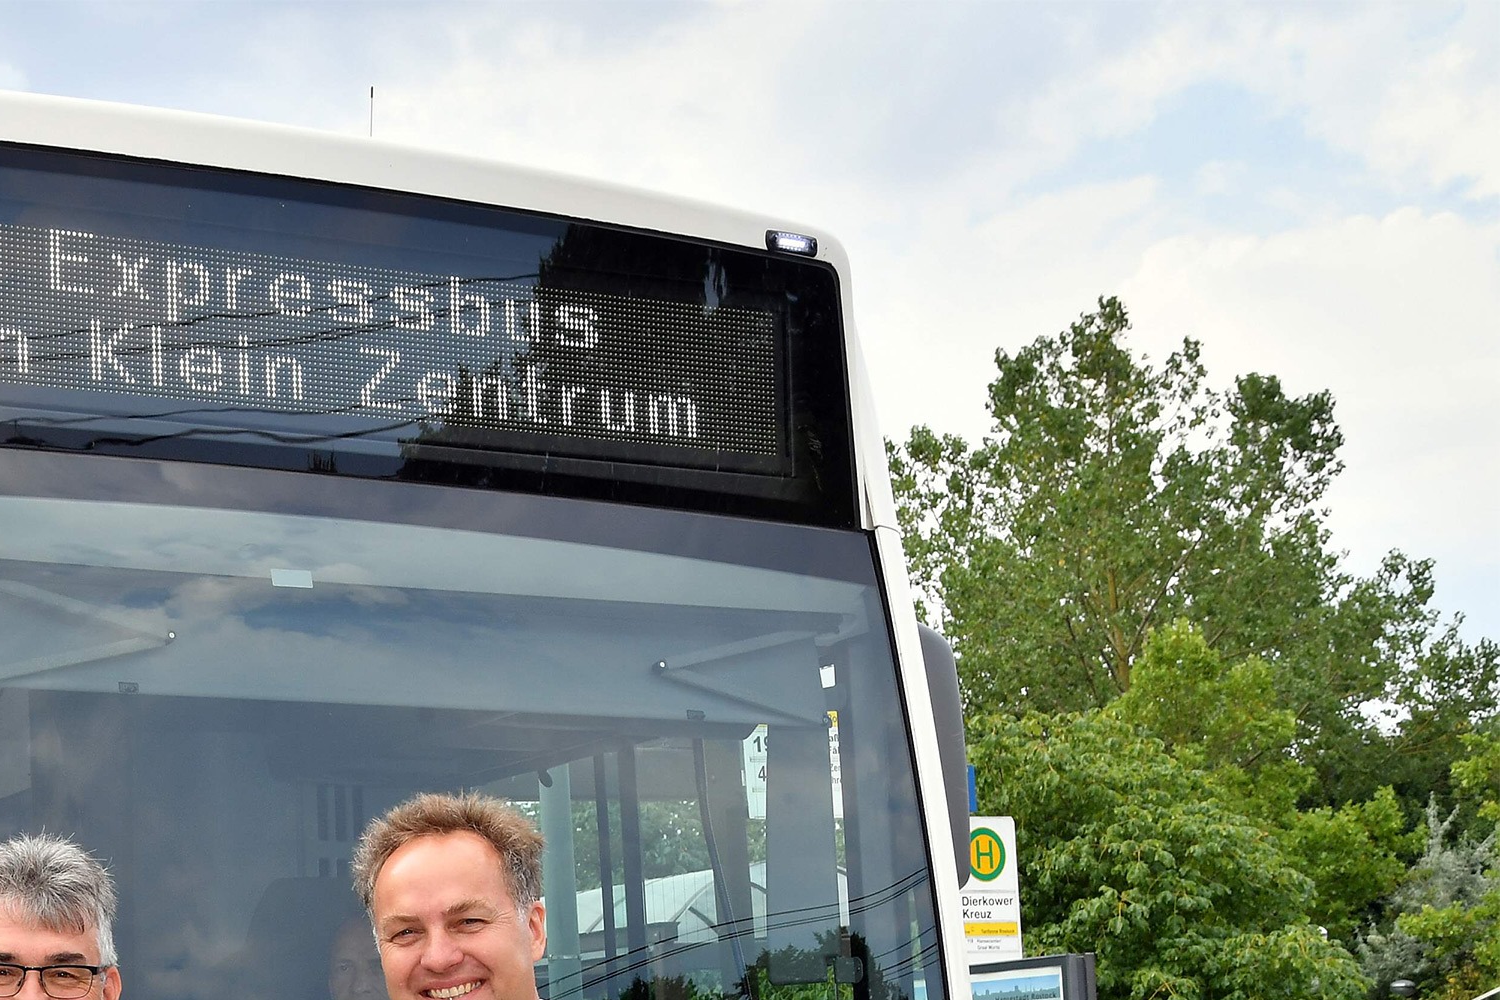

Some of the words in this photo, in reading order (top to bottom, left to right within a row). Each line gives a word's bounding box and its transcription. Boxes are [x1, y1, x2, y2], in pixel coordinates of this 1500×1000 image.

[48, 228, 599, 349] Expressbus
[89, 318, 303, 403] Klein
[359, 347, 699, 438] Zentrum
[975, 840, 994, 869] H
[961, 896, 1013, 906] Dierkower
[962, 909, 992, 919] Kreuz
[1031, 991, 1057, 1000] Rostock
